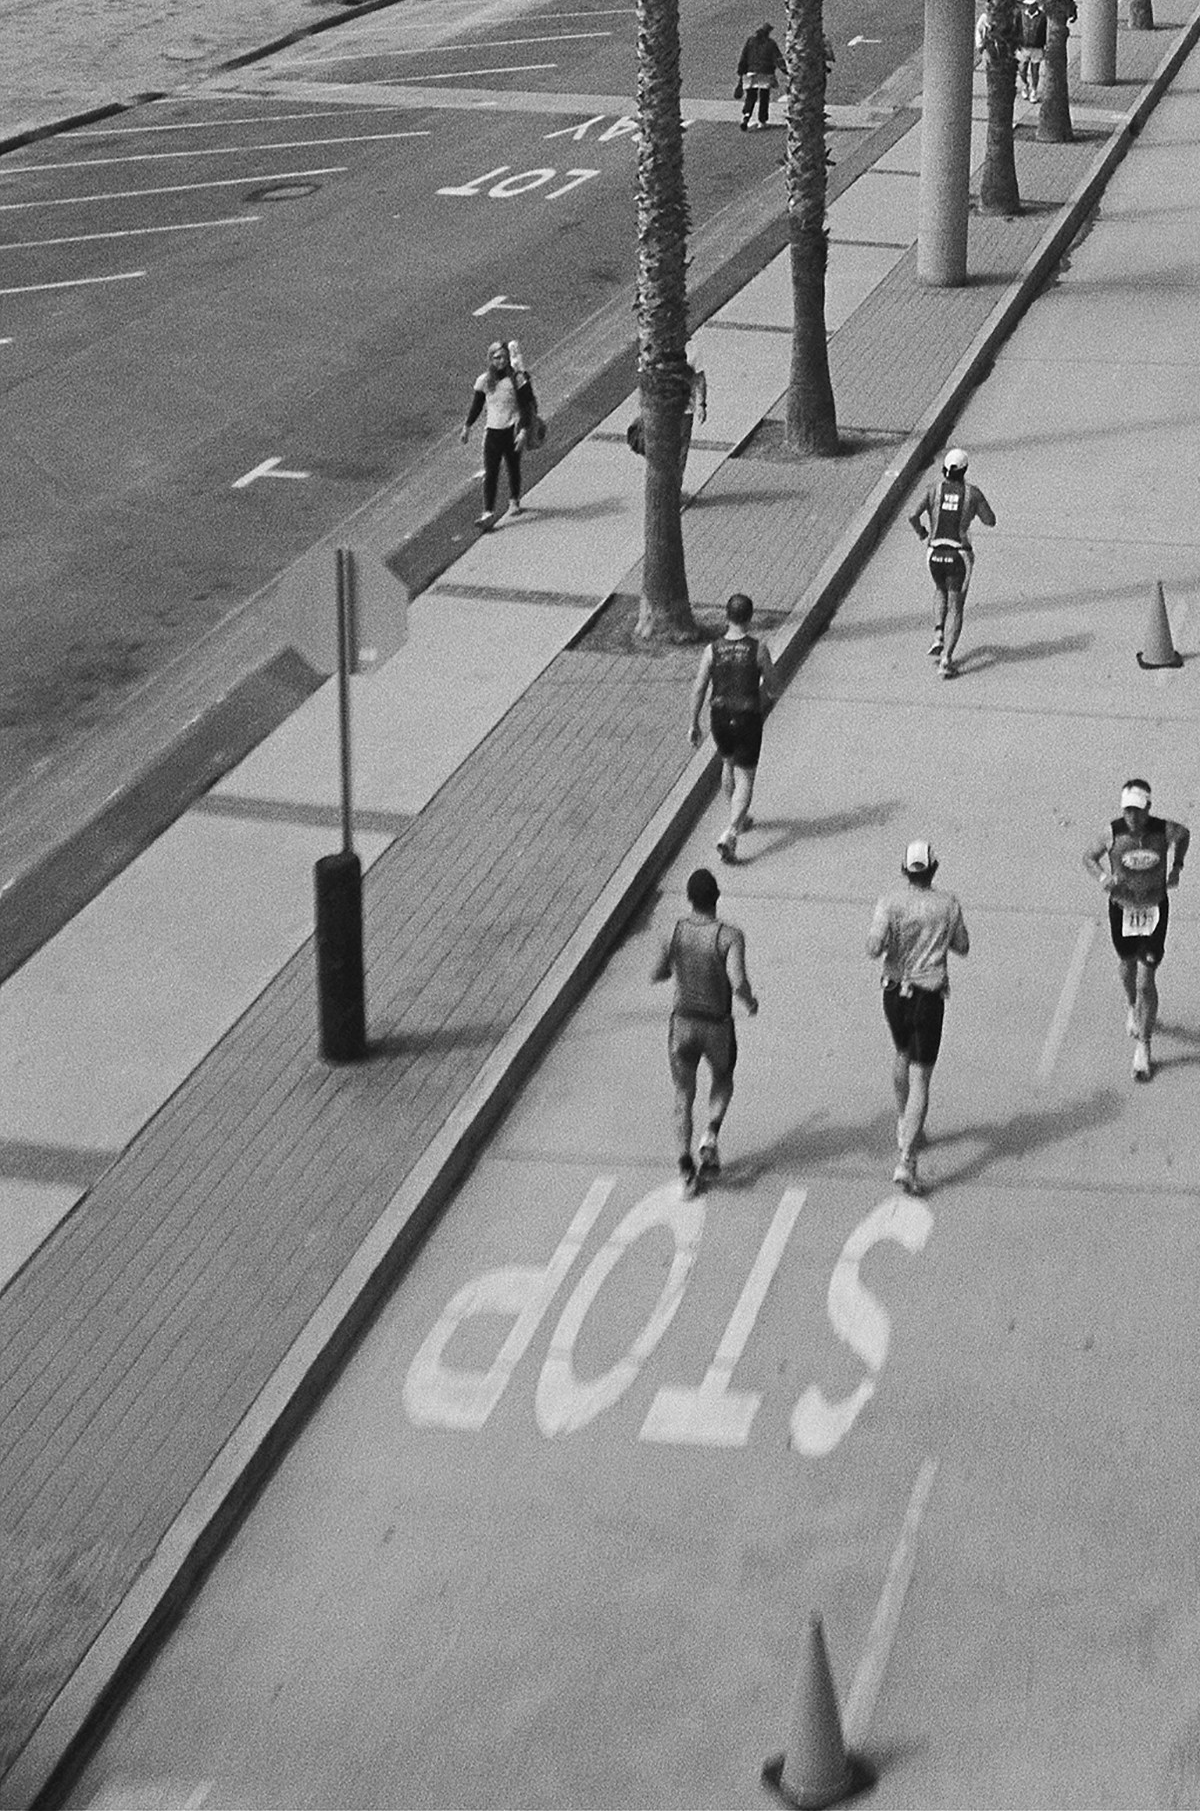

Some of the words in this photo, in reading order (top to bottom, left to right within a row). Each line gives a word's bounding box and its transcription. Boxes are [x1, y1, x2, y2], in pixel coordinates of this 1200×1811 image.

[543, 114, 698, 141] AY
[434, 164, 601, 199] LOT
[402, 1175, 935, 1457] STOP
